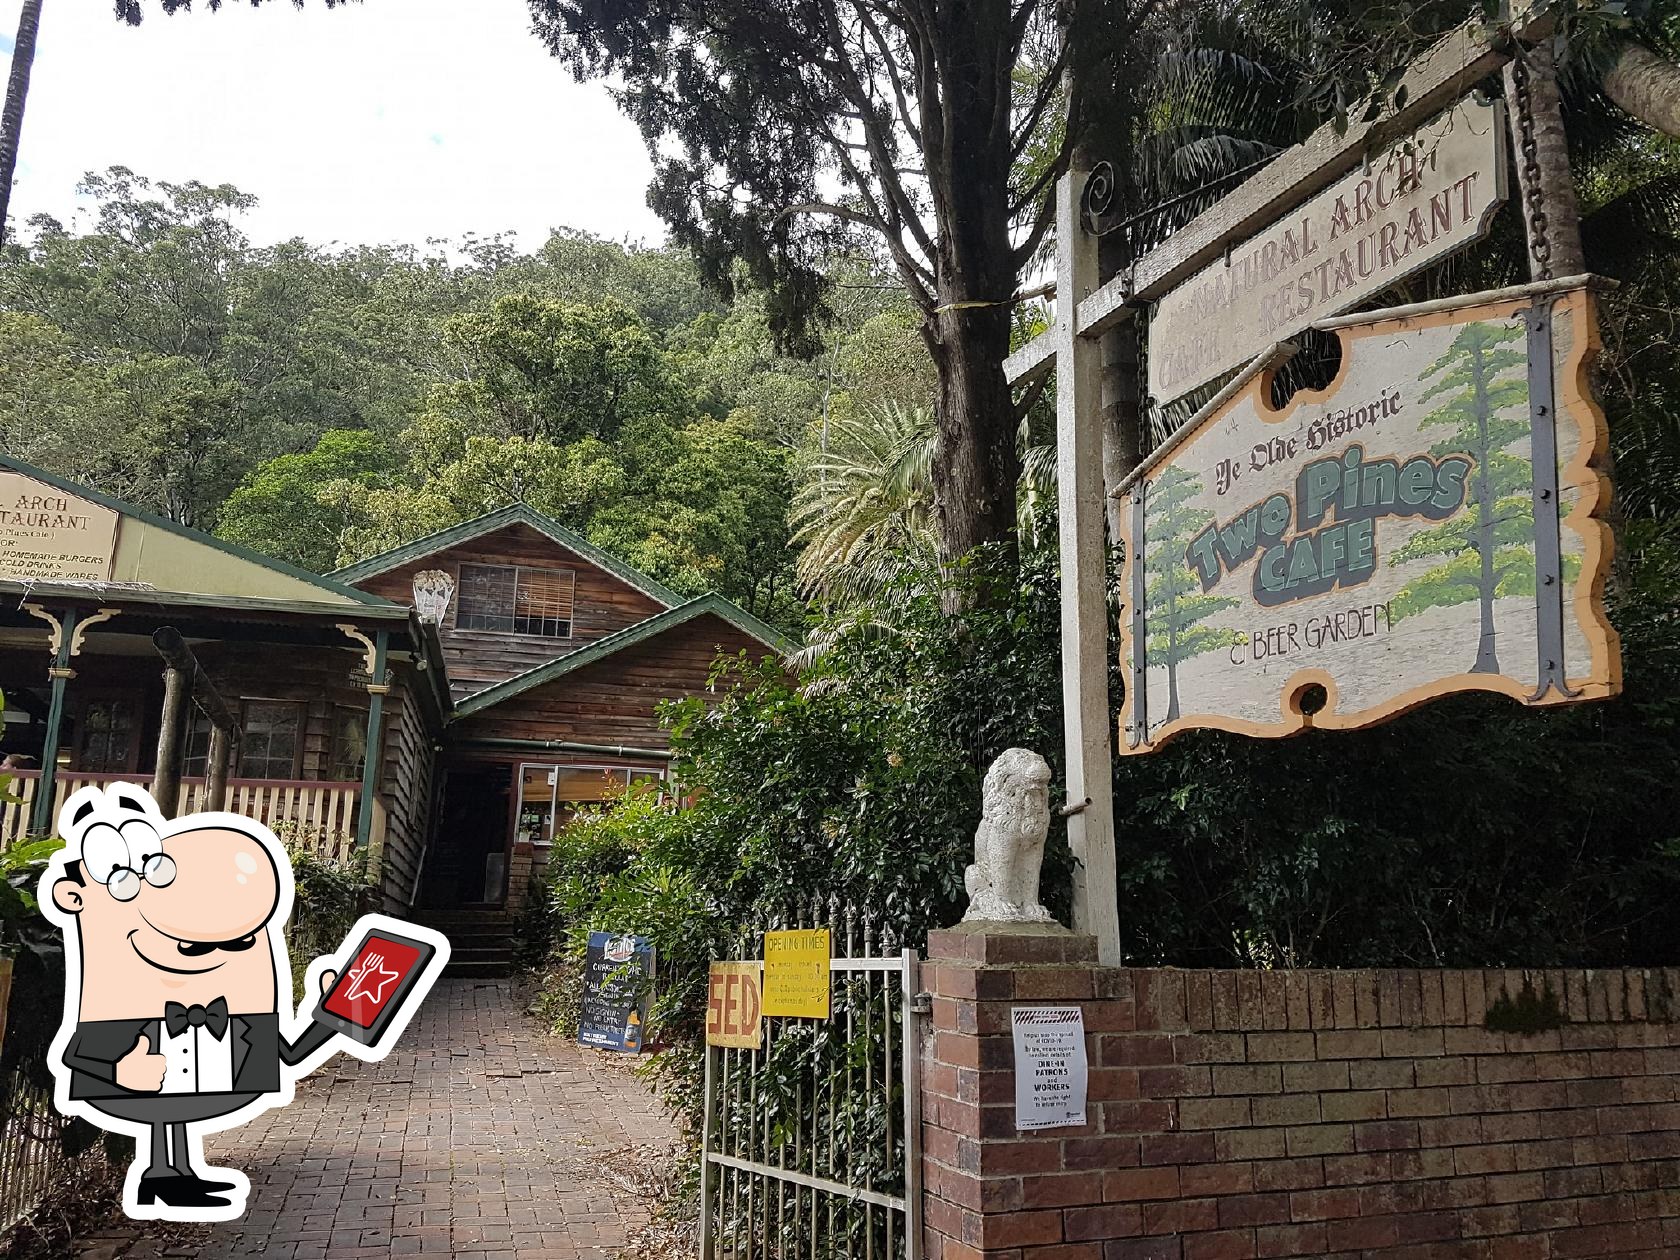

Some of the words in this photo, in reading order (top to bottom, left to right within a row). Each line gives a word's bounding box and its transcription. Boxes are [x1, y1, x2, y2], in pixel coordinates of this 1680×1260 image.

[1192, 216, 1318, 325] NATURAL
[1327, 148, 1422, 242] ARCH
[1258, 171, 1480, 338] RESTAURANT
[1215, 458, 1241, 496] Ye
[1249, 435, 1298, 473] Olde
[1306, 389, 1404, 451] Historic
[1297, 446, 1473, 529] Pines
[15, 495, 67, 512] ARCH
[0, 559, 25, 567] COLD
[26, 560, 62, 569] DRINKS
[2, 550, 57, 560] HOMEMADE
[59, 555, 104, 565] BURGERS
[1254, 518, 1376, 606] CAFE
[10, 568, 63, 578] HANDMADE
[65, 572, 99, 580] WARES
[1254, 622, 1302, 661] BEER
[1305, 602, 1392, 648] GARDEN
[768, 937, 799, 951] OPENING
[801, 936, 825, 950] TIMES
[709, 974, 759, 1036] SED
[1035, 1068, 1068, 1076] PATRONS
[1038, 1060, 1065, 1068] DINE-IN
[1034, 1083, 1070, 1092] WORKERS
